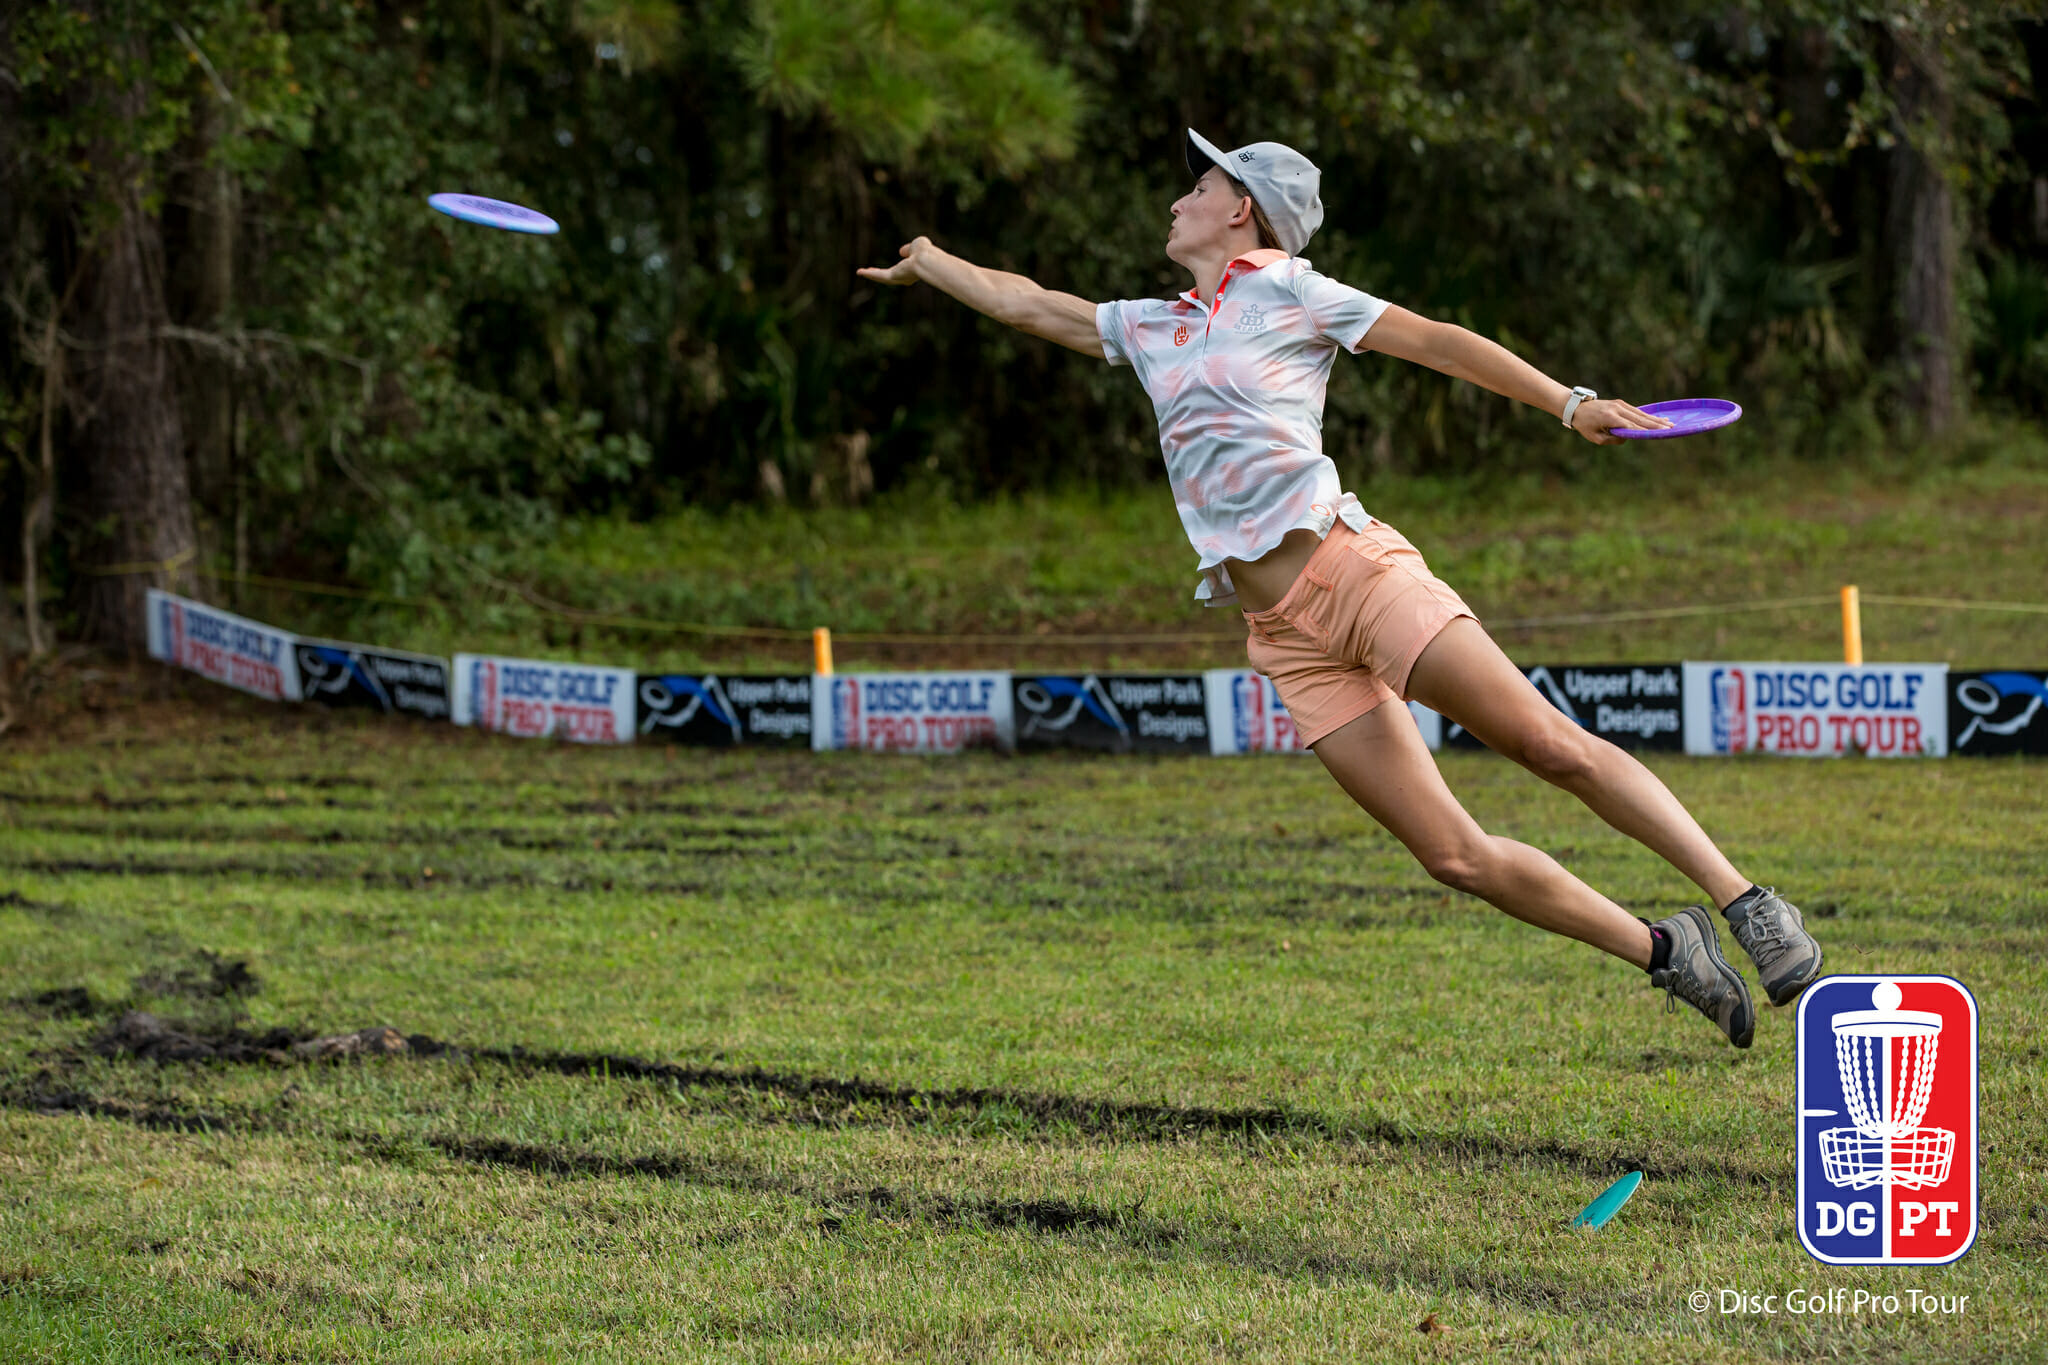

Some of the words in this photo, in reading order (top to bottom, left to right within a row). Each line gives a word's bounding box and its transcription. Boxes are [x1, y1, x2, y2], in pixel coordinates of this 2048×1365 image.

[502, 666, 552, 699] DISC
[558, 669, 618, 704] GOLF
[866, 680, 922, 712] DISC
[928, 680, 994, 712] GOLF
[1110, 679, 1162, 709] Upper
[1162, 679, 1202, 704] Park
[1564, 669, 1629, 703] Upper
[1630, 668, 1679, 696] Park
[1755, 672, 1829, 708] DISC
[1836, 672, 1923, 709] GOLF
[502, 699, 546, 735] PRO
[866, 716, 918, 748] PRO
[1138, 711, 1205, 742] Designs
[1597, 703, 1679, 738] Designs
[1756, 714, 1820, 750] PRO
[1828, 715, 1923, 753] TOUR
